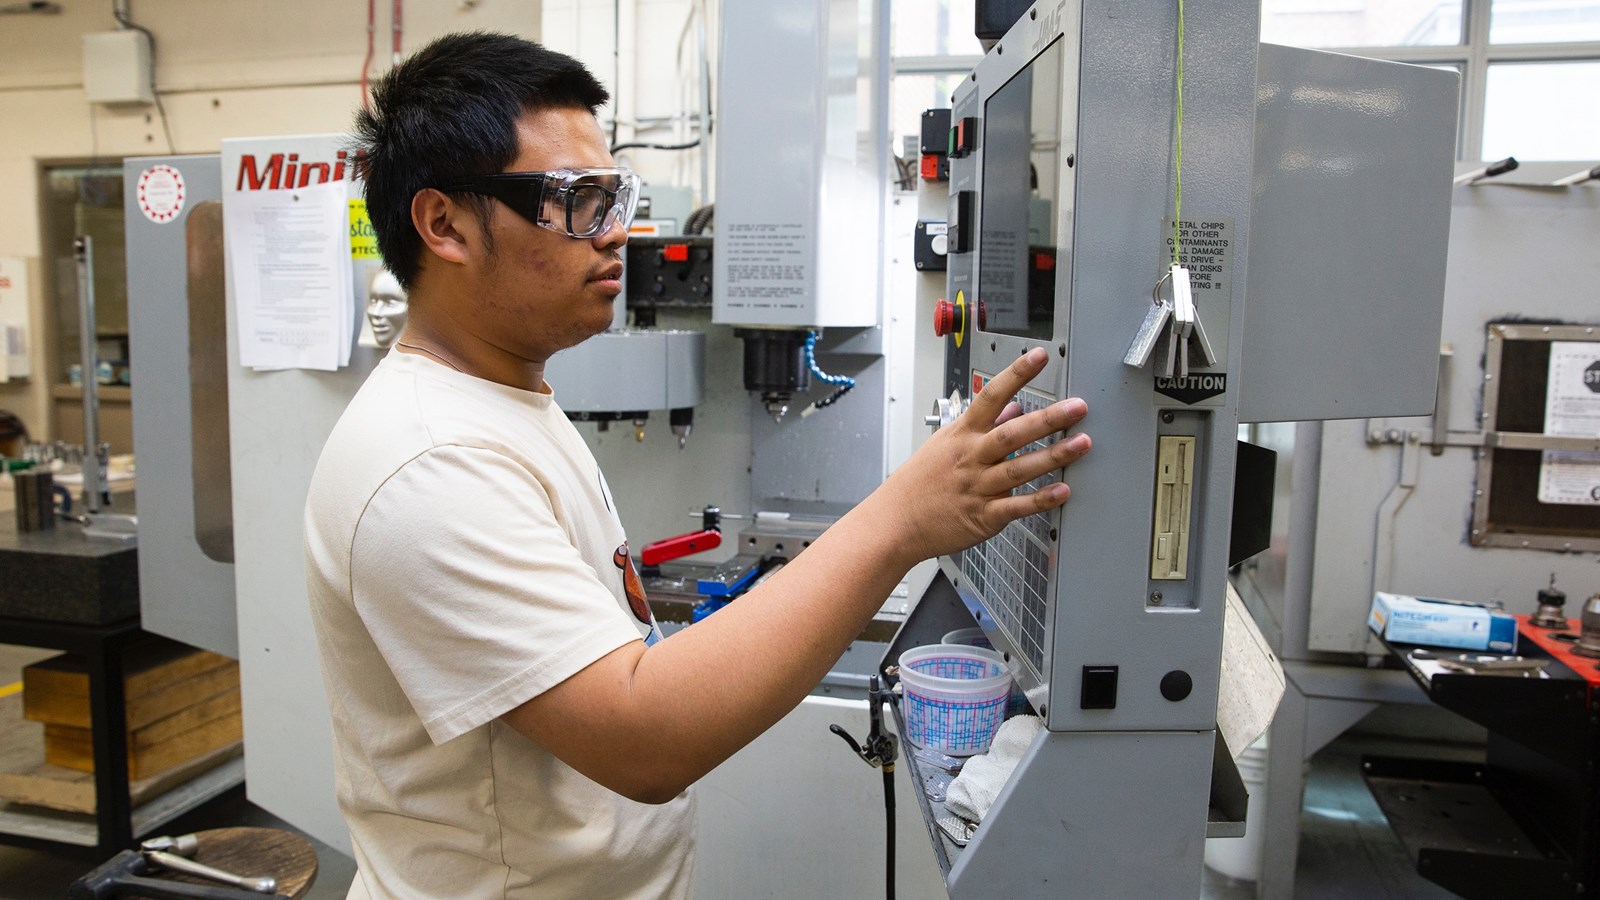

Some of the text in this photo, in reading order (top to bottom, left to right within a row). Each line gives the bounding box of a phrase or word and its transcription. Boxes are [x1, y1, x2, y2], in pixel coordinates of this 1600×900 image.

[236, 150, 348, 191] Mini
[1201, 222, 1225, 230] CHIPS
[1192, 230, 1219, 238] OTHER
[1166, 238, 1229, 247] CNTAMINANTS
[1191, 247, 1225, 256] DAMAGE
[1191, 256, 1215, 264] DRIVE
[1156, 376, 1225, 390] CAUTION
